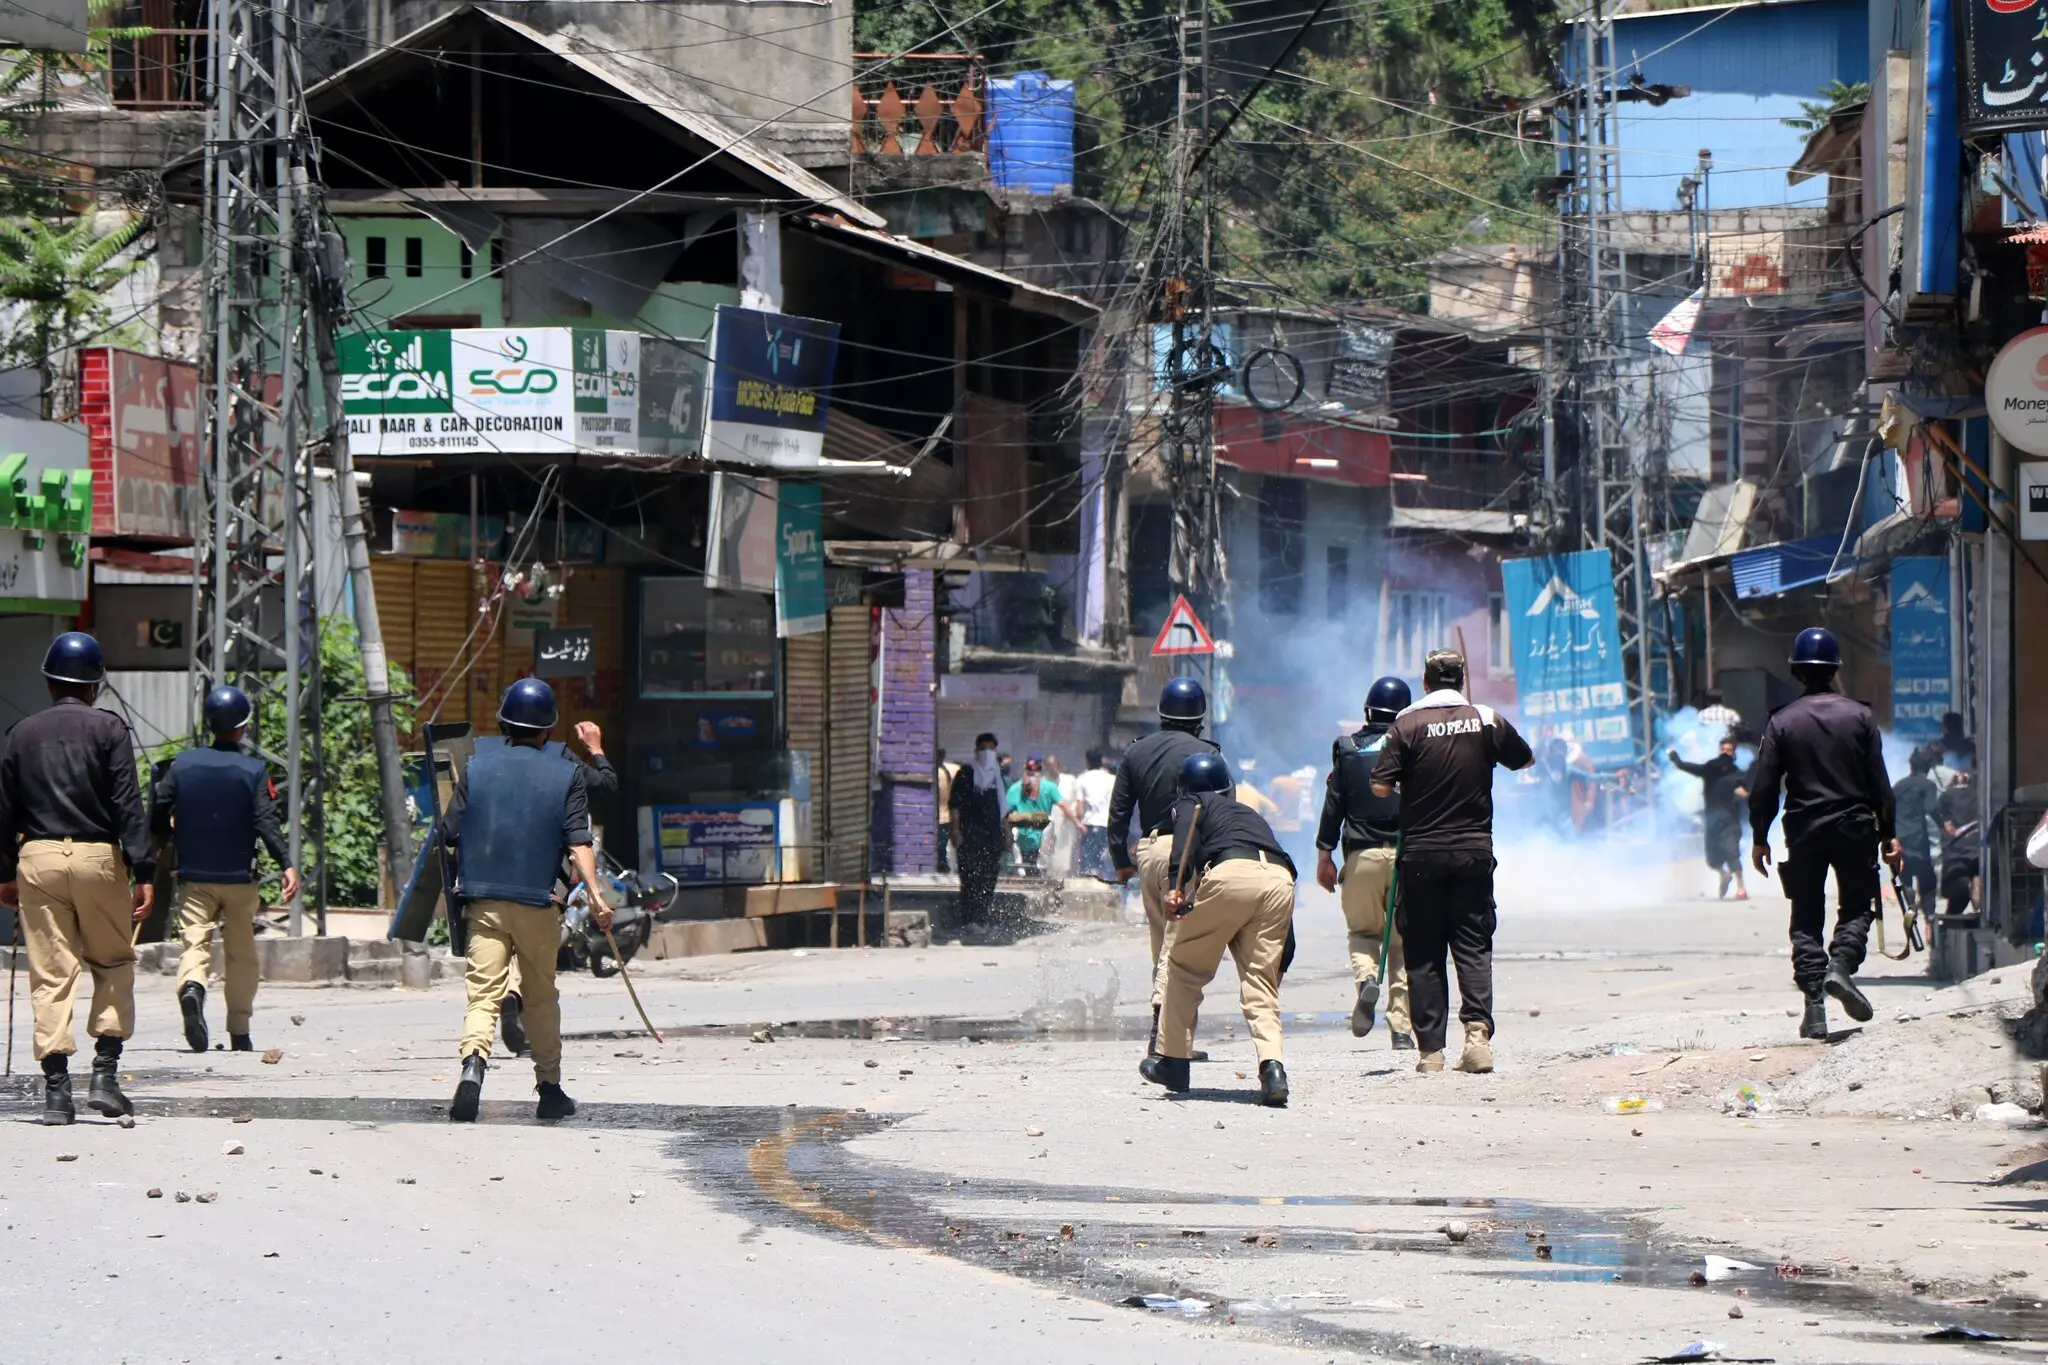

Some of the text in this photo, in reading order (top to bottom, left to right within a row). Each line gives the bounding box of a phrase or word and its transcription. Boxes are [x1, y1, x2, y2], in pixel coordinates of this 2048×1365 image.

[469, 369, 557, 394] SCO
[424, 417, 433, 433] &
[441, 416, 468, 433] CAR
[475, 415, 563, 432] DECORATION
[1427, 718, 1481, 738] NO FEAR
